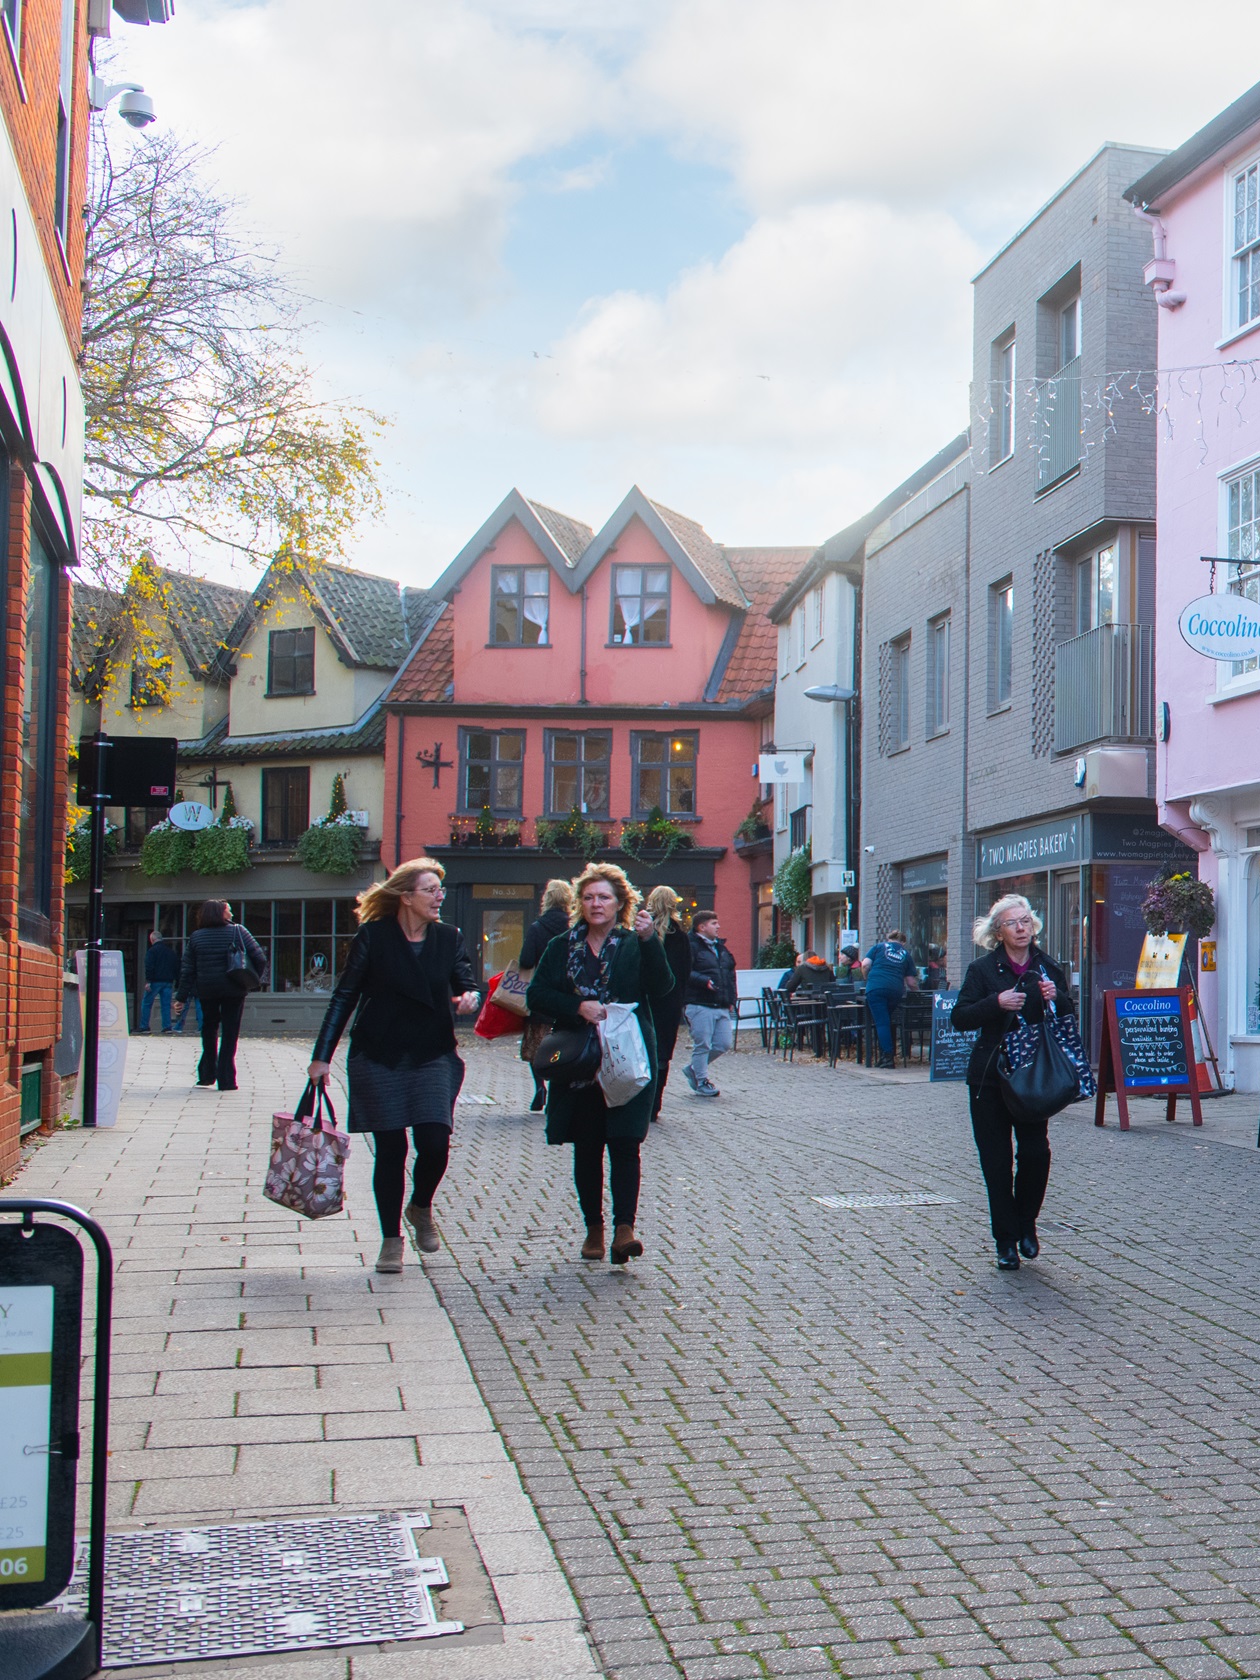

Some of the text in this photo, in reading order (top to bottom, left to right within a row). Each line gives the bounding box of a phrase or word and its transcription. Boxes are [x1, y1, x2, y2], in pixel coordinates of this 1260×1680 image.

[1201, 645, 1256, 658] www.coccolino.co.uk
[184, 804, 202, 823] W
[1133, 828, 1171, 838] @2magpi
[988, 832, 1068, 866] TWO MAGPIES BAKERY
[1122, 839, 1137, 847] Two
[1139, 839, 1172, 849] Magpies
[1096, 850, 1199, 861] www.twomagpiesbakery.c
[502, 970, 530, 992] Boo
[1124, 999, 1171, 1012] Coccolino
